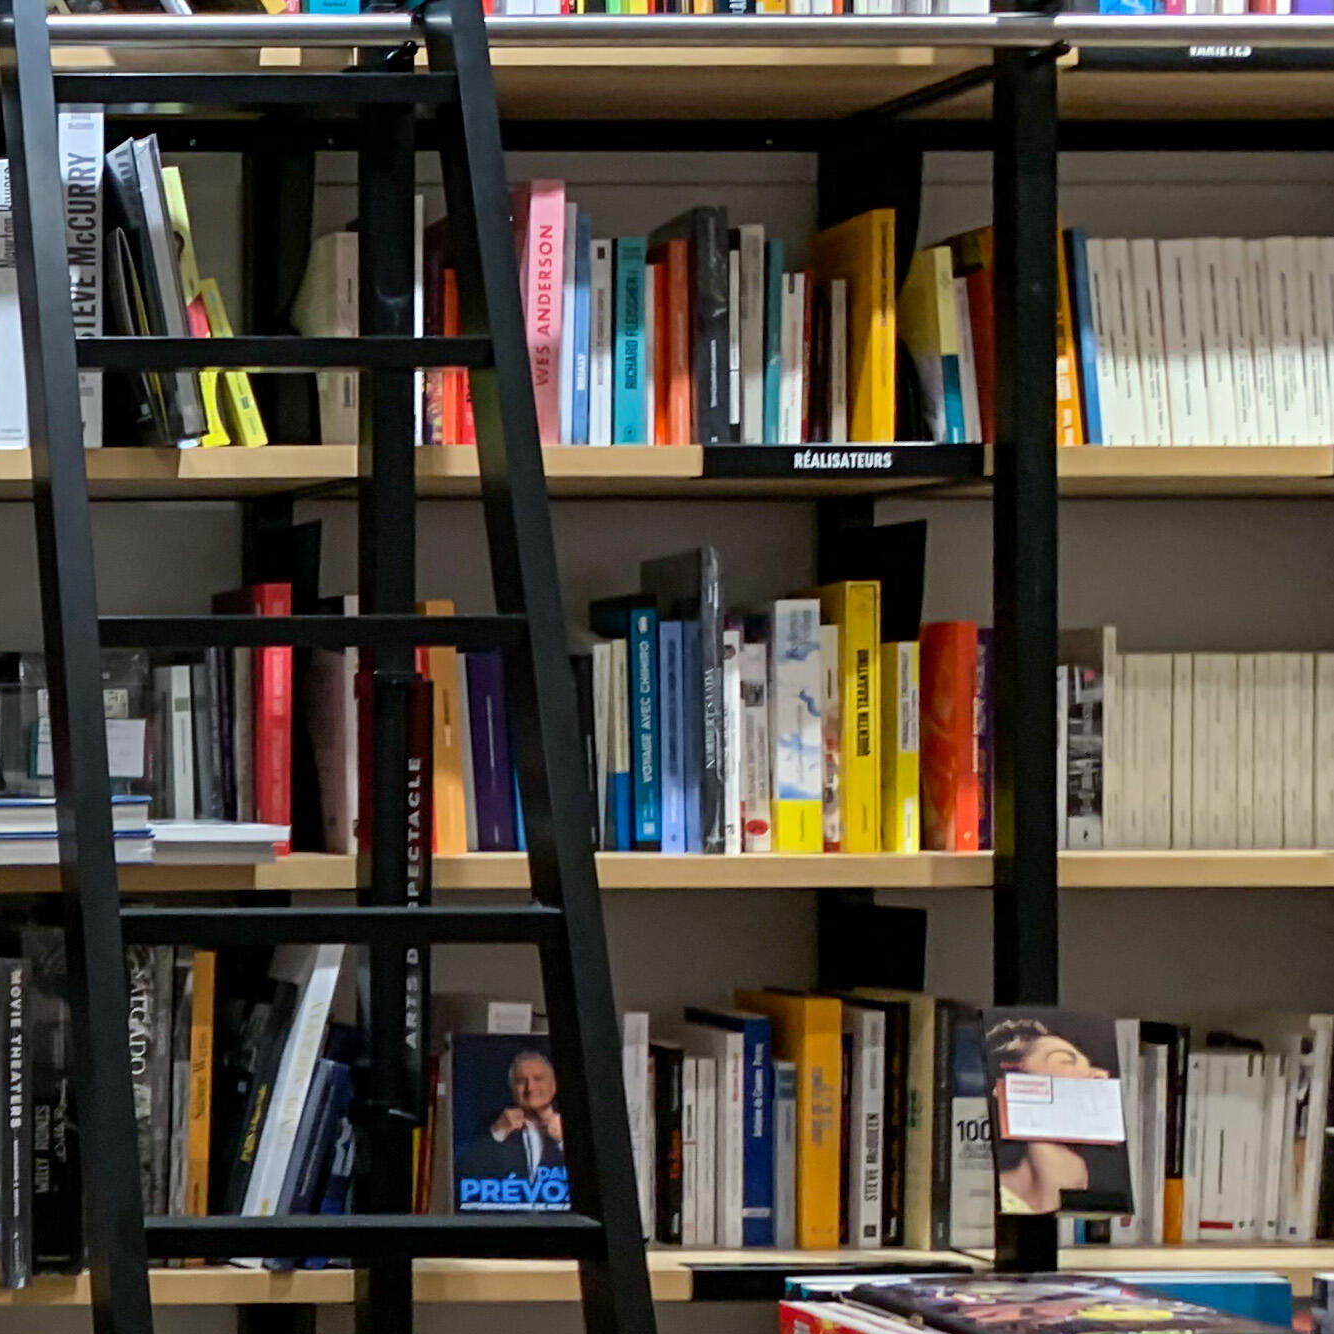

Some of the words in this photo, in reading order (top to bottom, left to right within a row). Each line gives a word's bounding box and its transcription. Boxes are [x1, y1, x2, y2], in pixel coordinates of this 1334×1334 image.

[68, 152, 96, 267] McCURRY
[537, 225, 553, 336] ANDERSON
[535, 346, 549, 387] WES
[624, 340, 638, 390] RICHARD
[793, 451, 893, 469] RÉALISATEURS
[638, 640, 650, 693] CHIHIRO
[856, 649, 869, 711] TARANTINO
[639, 696, 652, 730] AVEC
[10, 970, 22, 1028] MOVIE
[129, 969, 150, 1075] SALGADO
[405, 975, 419, 1049] ARTS
[10, 1034, 22, 1129] THEATERS
[460, 1171, 570, 1203] PRÉVO
[866, 1168, 881, 1202] STEVE
